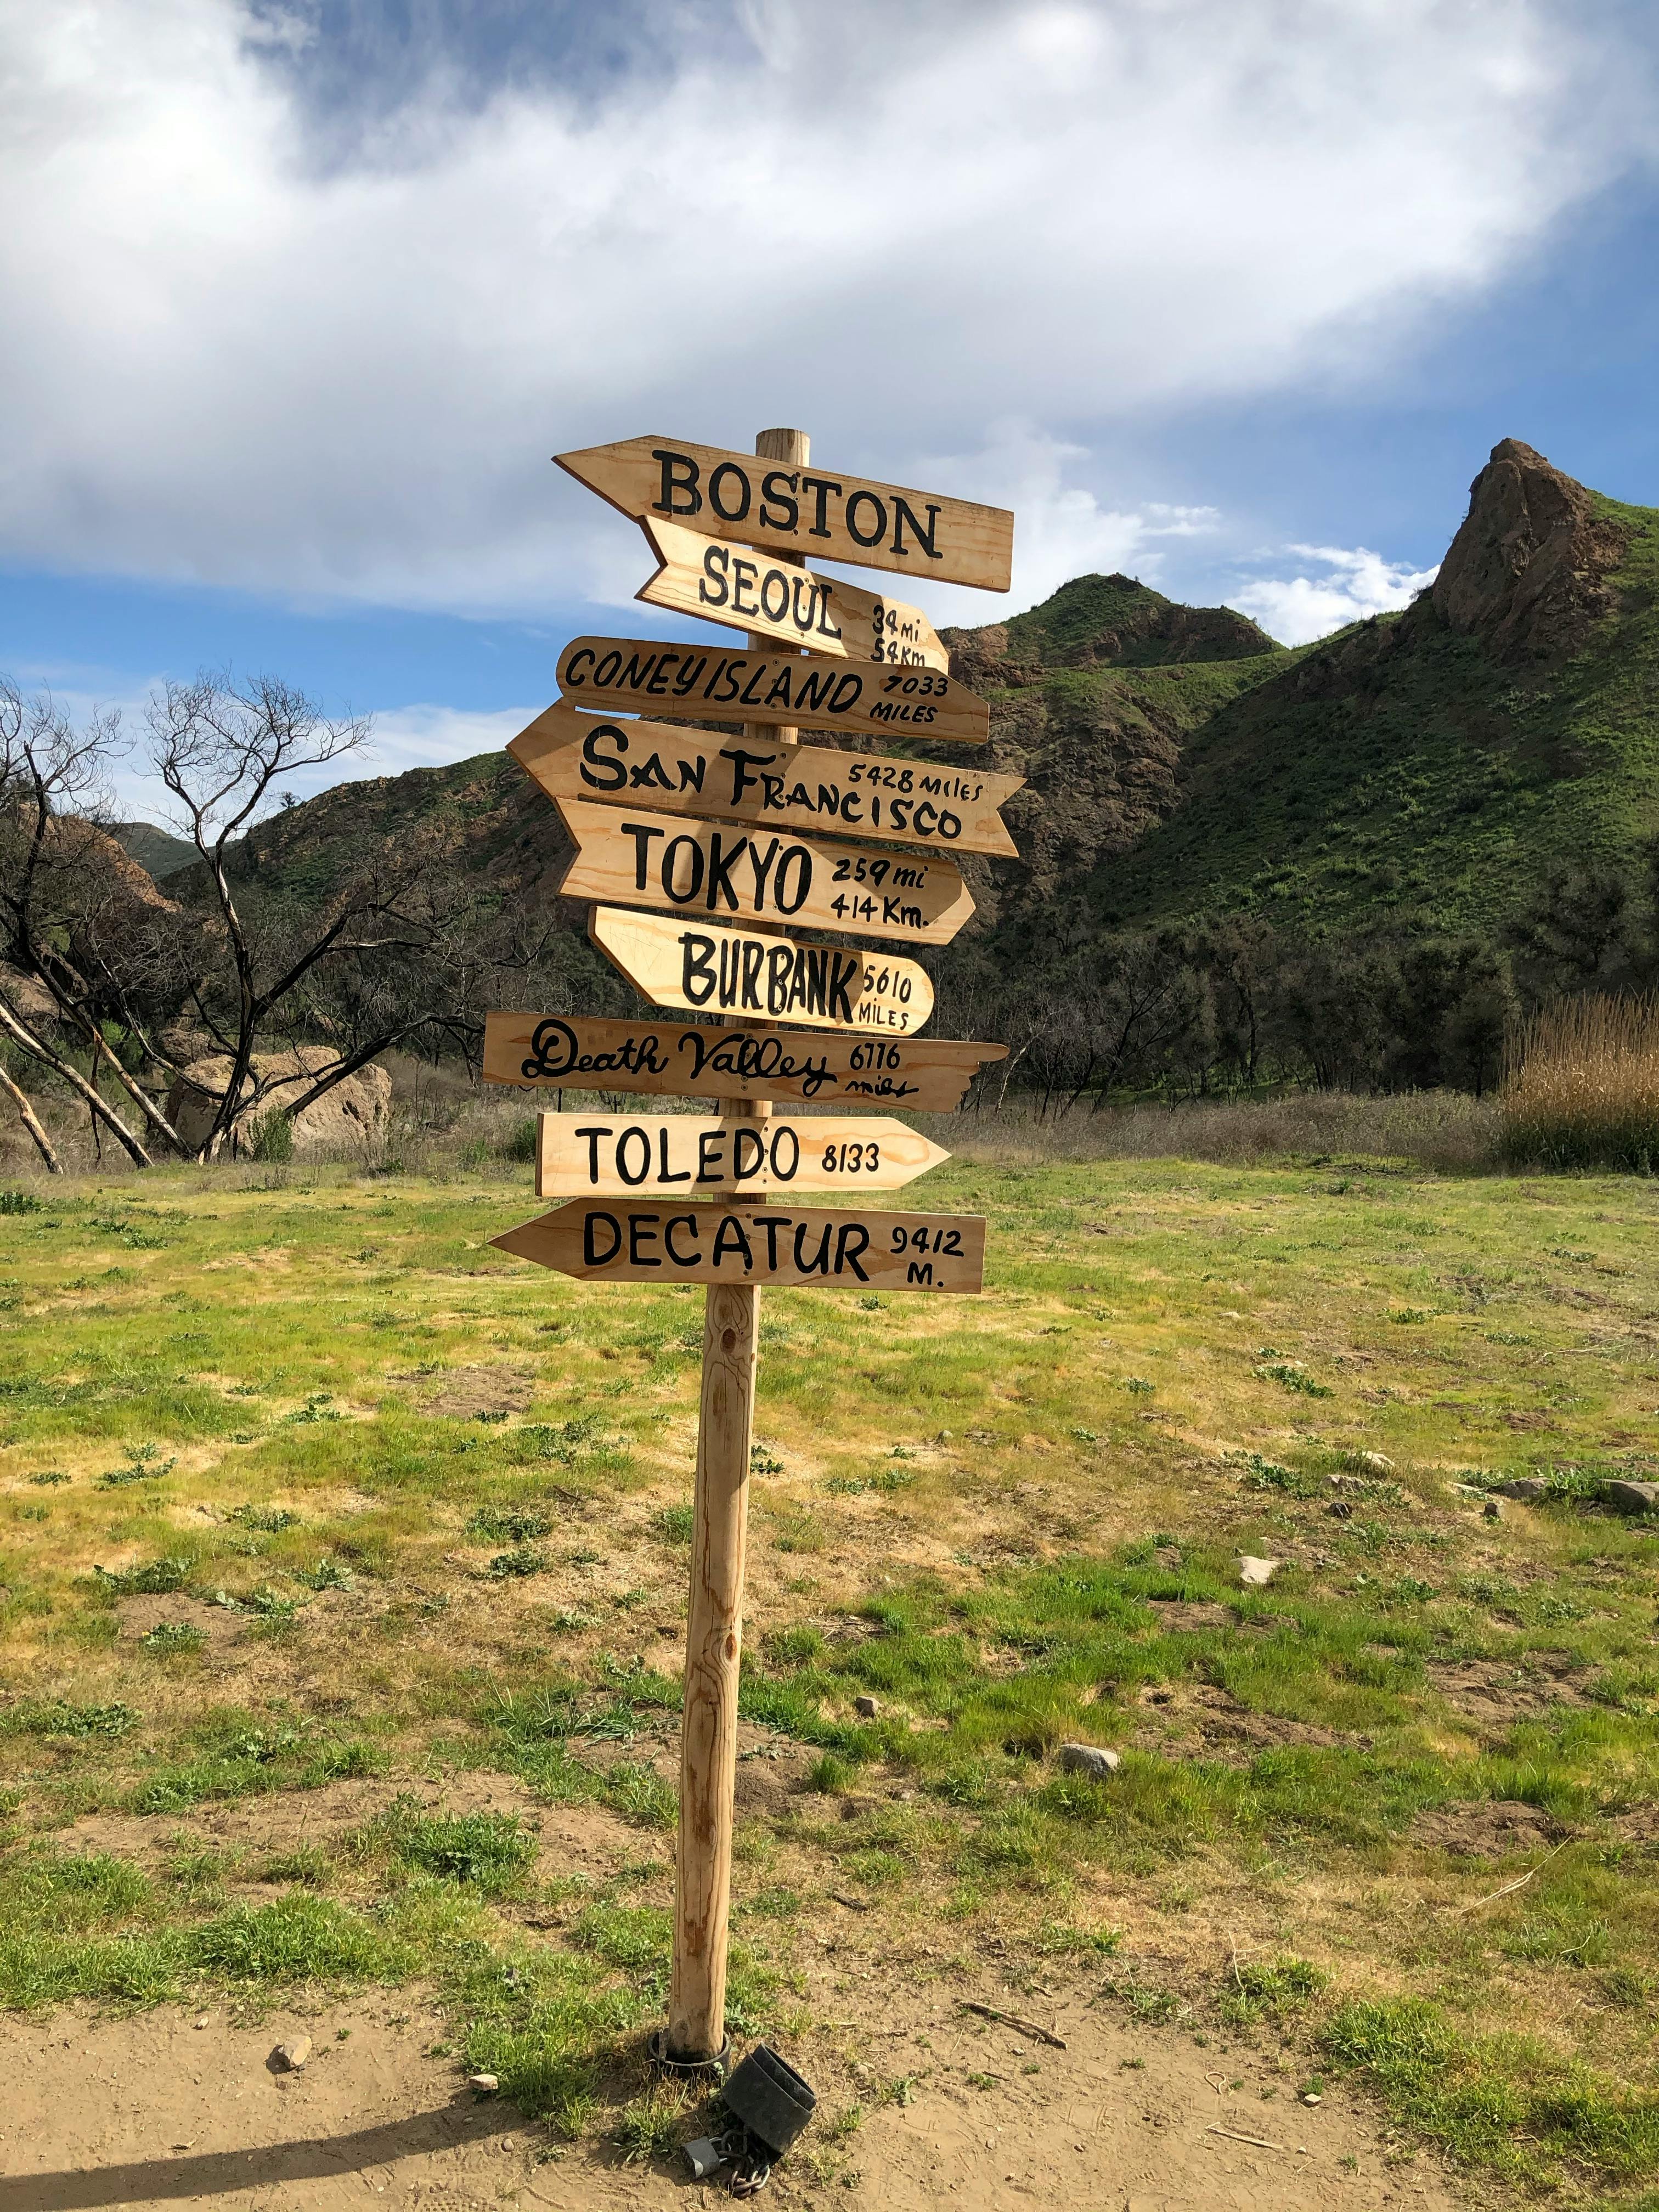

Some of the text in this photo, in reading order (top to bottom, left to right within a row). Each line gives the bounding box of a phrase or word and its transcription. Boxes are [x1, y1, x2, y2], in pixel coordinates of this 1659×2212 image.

[652, 450, 943, 559] BOSTON
[699, 545, 842, 640] SEOUL
[872, 605, 898, 635] 34
[870, 638, 898, 663] 54
[565, 649, 863, 713] CONEY ISLAND
[884, 675, 948, 697] 7033
[870, 702, 938, 723] MILES
[848, 764, 913, 793] 5428
[622, 823, 812, 915] TOKYO
[832, 857, 929, 889] 259 mi
[831, 894, 878, 923] 414
[678, 932, 859, 1025] BURBANK
[864, 964, 911, 1003] 5610
[521, 1018, 838, 1097] Death Valley
[850, 1042, 900, 1071] 6776
[845, 1075, 919, 1098] miles
[574, 1126, 879, 1186] TOLEDO 8133
[583, 1211, 871, 1282] DECATUR
[890, 1226, 964, 1257] 9412
[907, 1261, 944, 1287] M.
